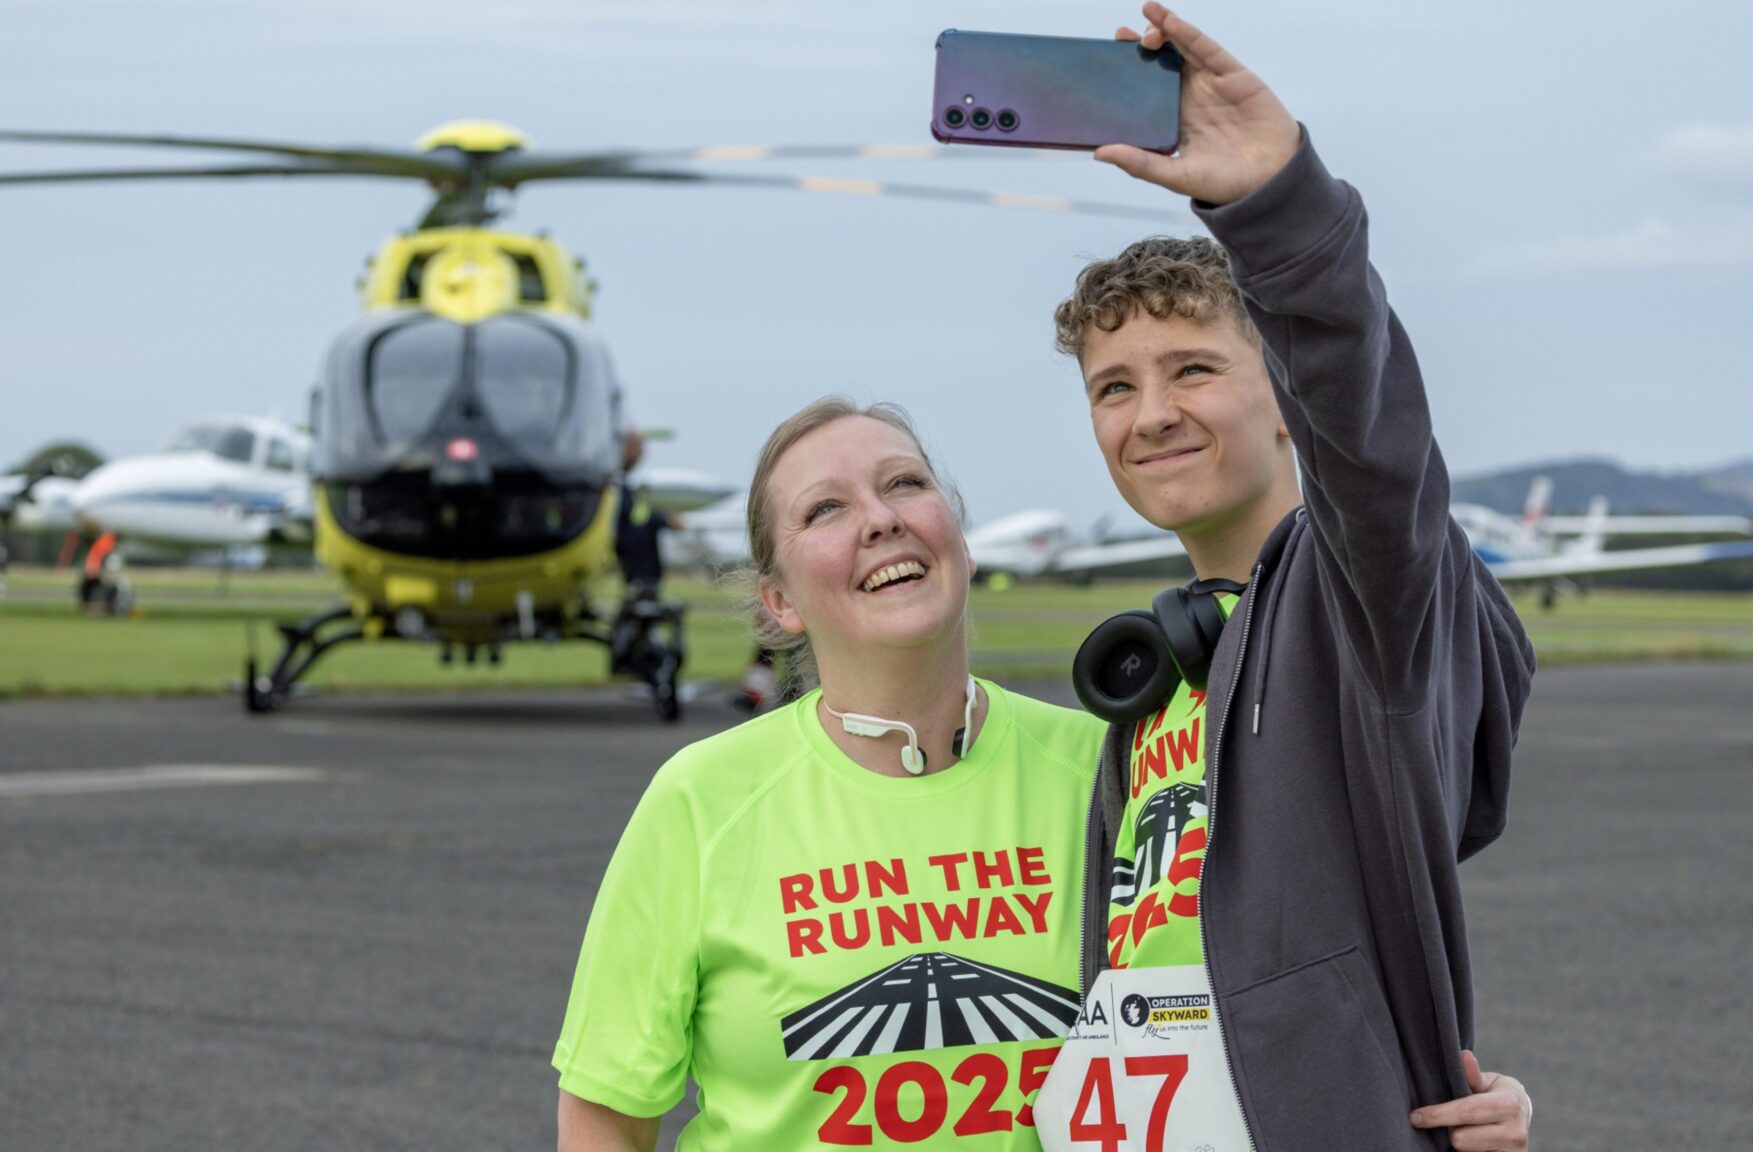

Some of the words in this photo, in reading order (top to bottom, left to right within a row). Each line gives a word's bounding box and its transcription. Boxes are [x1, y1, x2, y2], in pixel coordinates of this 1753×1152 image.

[1120, 653, 1140, 677] R
[779, 858, 909, 914] RUN
[928, 846, 1052, 892] THE
[786, 891, 1054, 958] RUNWAY
[1151, 996, 1208, 1008] OPERATION
[1152, 1009, 1208, 1022] SKYWARD
[1179, 1024, 1190, 1032] the
[1190, 1023, 1209, 1032] future
[812, 1046, 1063, 1146] 2025
[1069, 1053, 1189, 1152] 47
